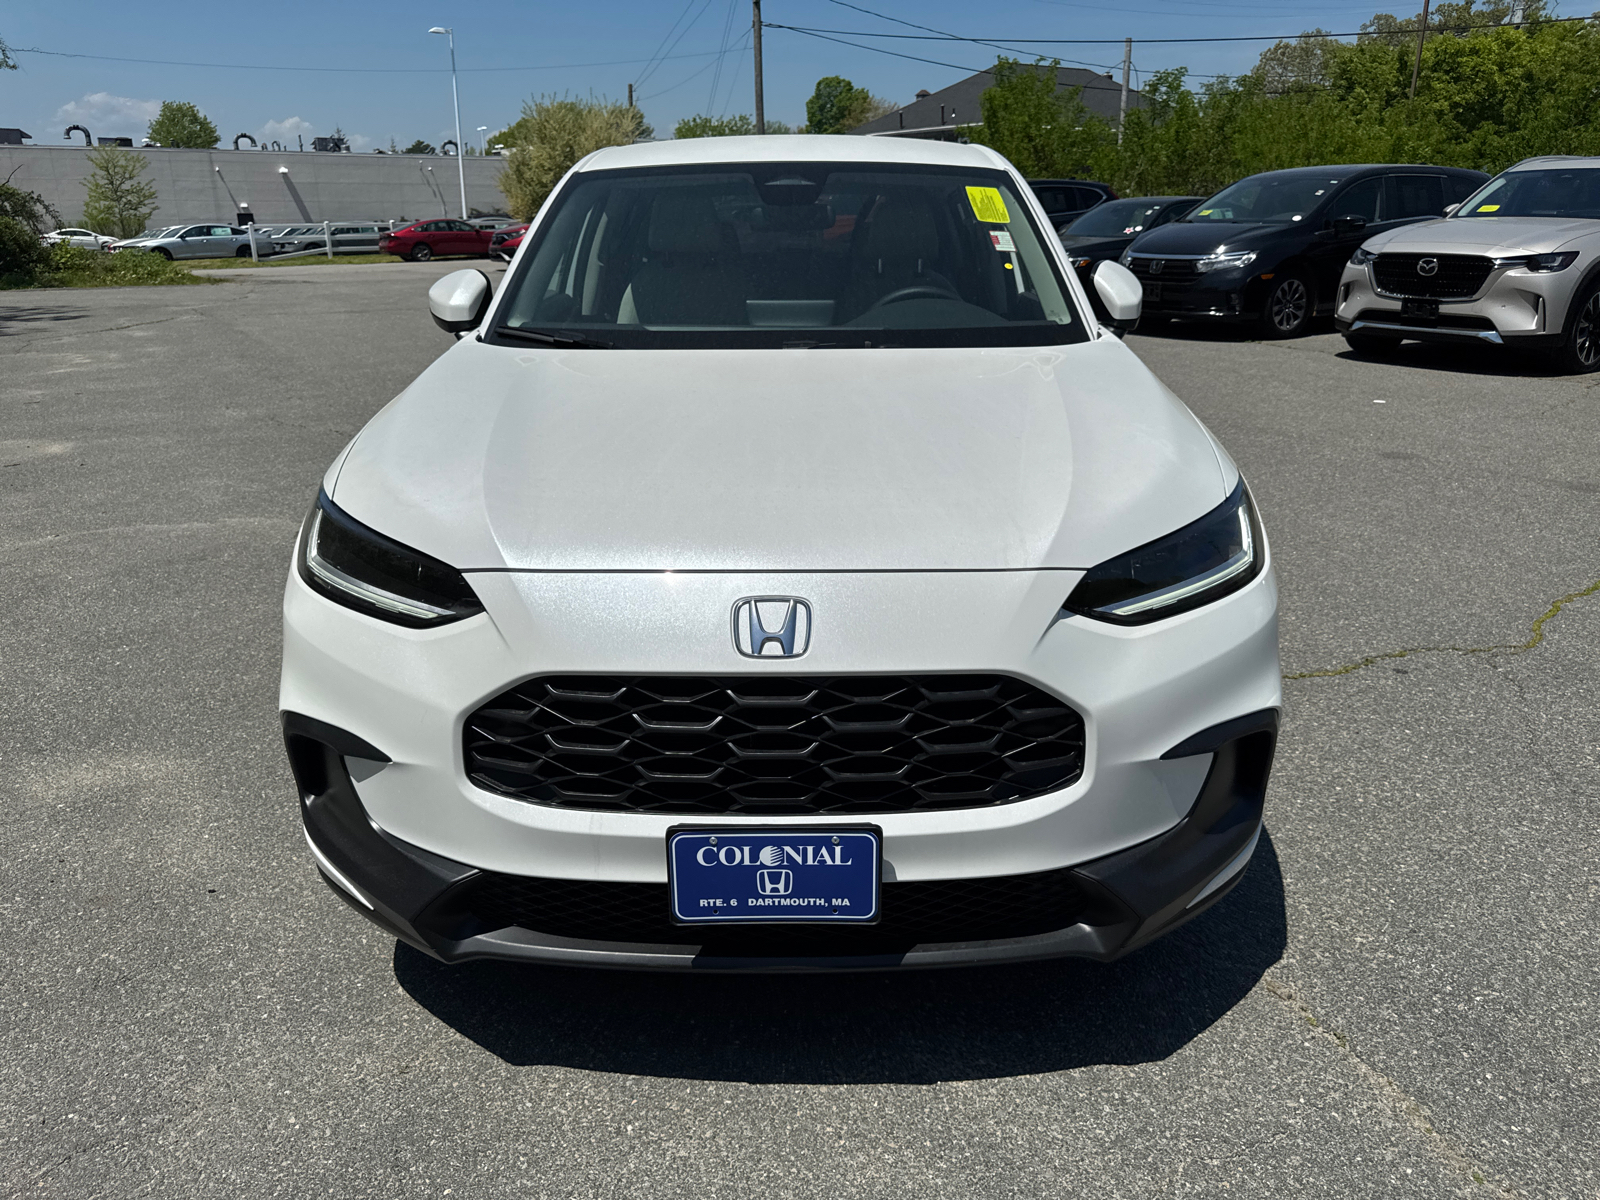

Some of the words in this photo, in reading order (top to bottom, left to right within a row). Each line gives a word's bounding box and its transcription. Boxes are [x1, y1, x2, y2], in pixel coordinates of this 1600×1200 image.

[696, 845, 853, 867] COLONIAL
[699, 898, 727, 907] RTE.
[730, 898, 738, 907] 6
[748, 898, 829, 908] DARTMOUTH,
[831, 898, 851, 906] MA
